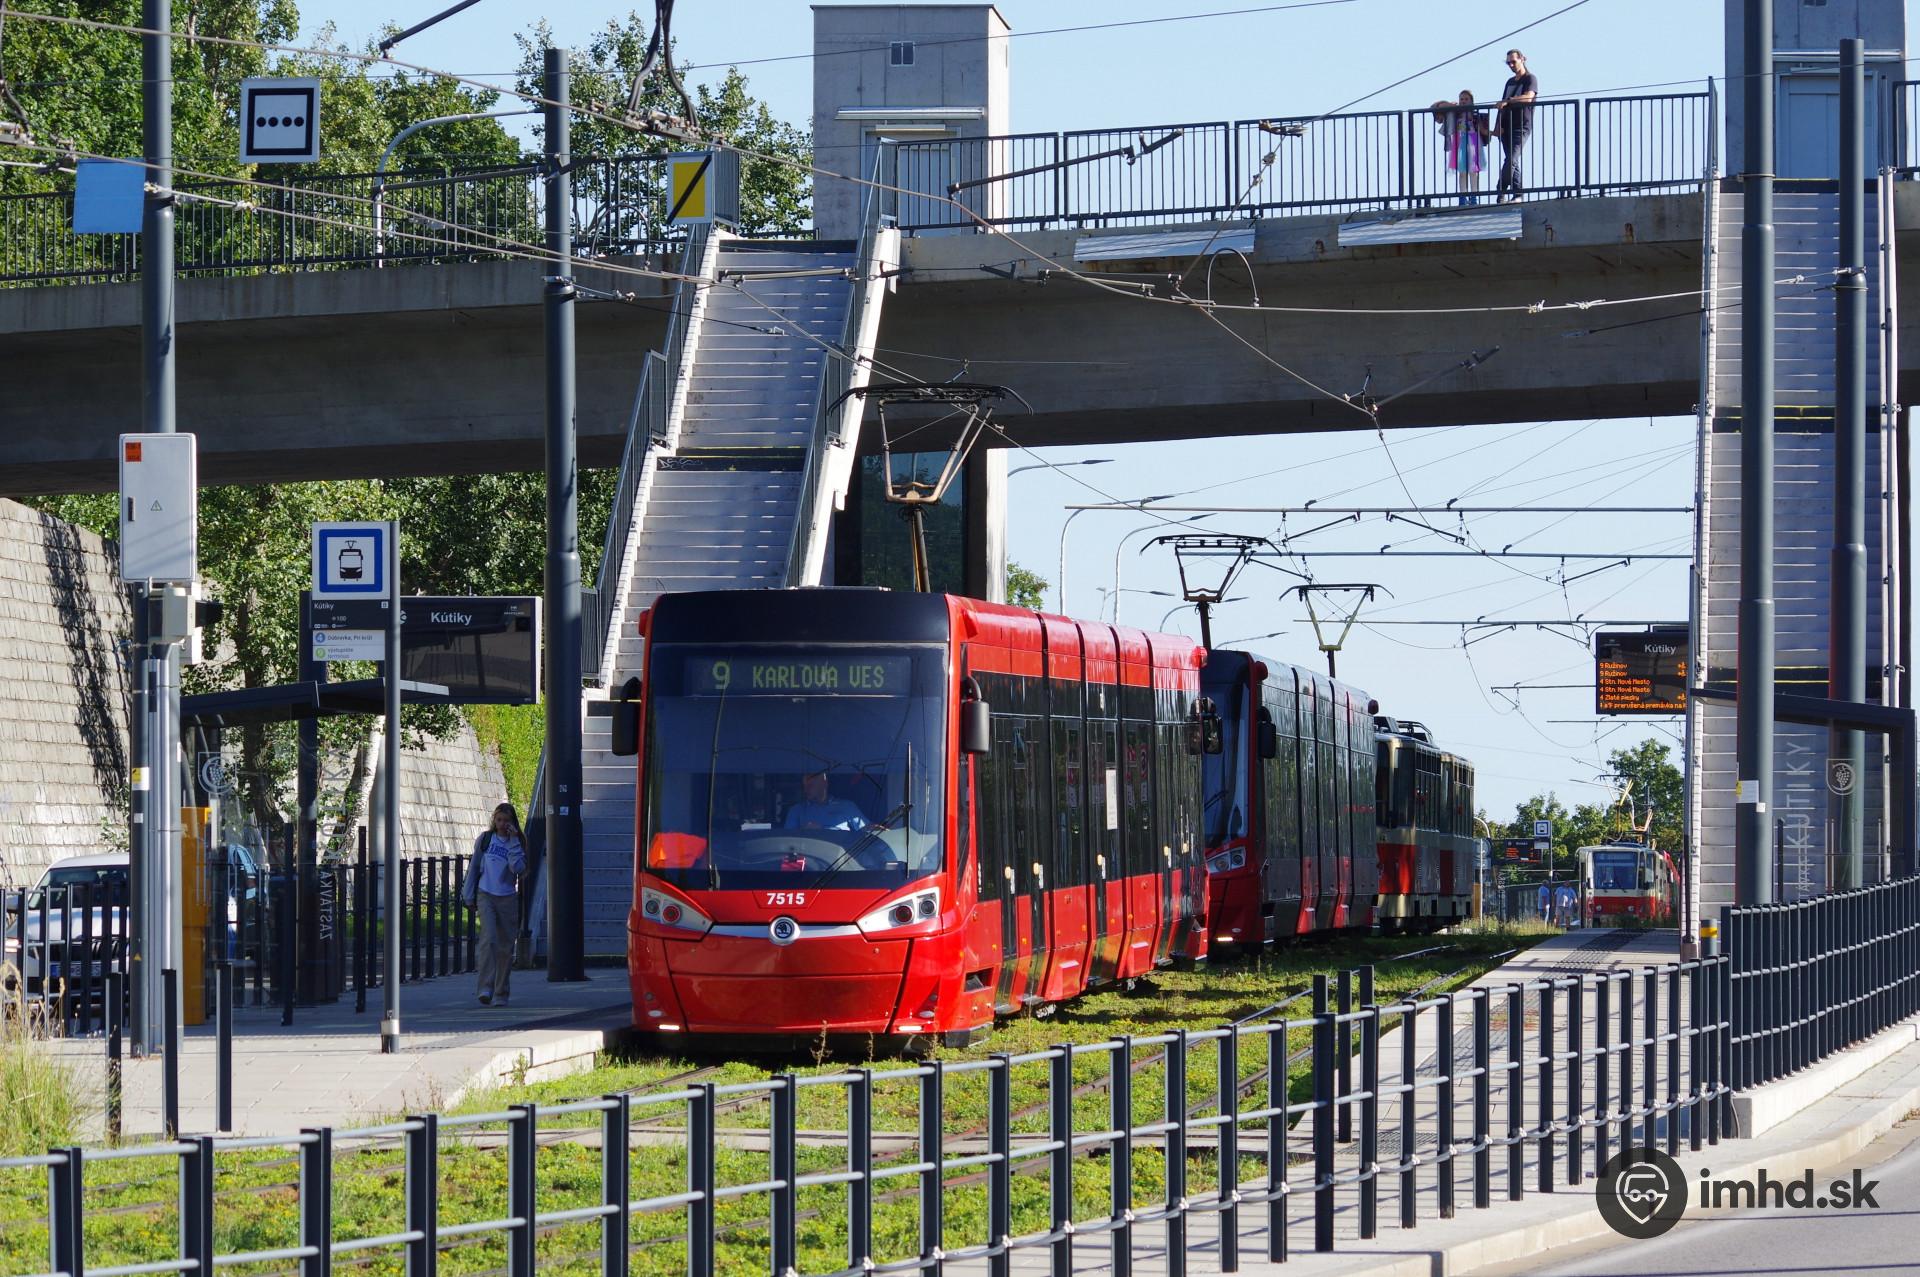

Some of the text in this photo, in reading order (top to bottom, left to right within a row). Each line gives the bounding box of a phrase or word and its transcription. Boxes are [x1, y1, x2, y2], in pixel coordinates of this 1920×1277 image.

[314, 602, 335, 611] Kútiky
[431, 612, 472, 626] Kútiky
[1644, 644, 1676, 655] Kútiky
[712, 660, 884, 690] 9 KARLOVA VES
[1782, 742, 1811, 849] KÚTIKY
[766, 892, 804, 905] 7515
